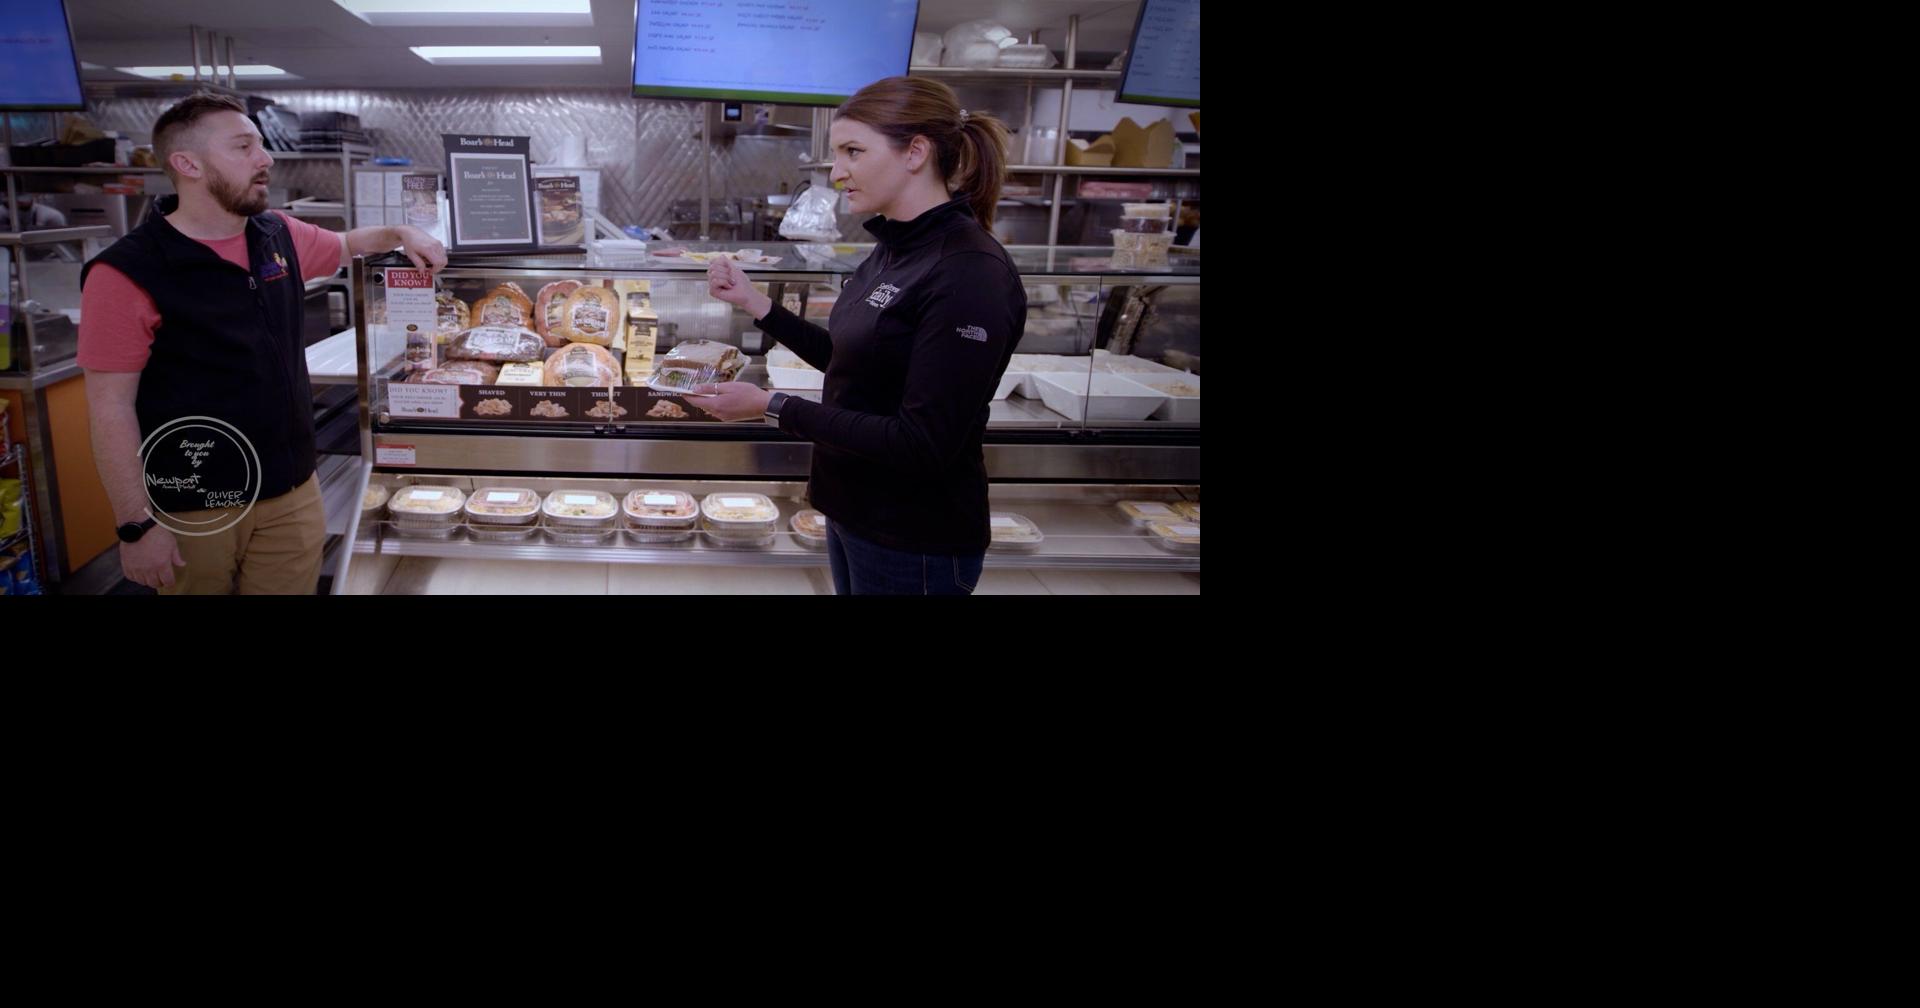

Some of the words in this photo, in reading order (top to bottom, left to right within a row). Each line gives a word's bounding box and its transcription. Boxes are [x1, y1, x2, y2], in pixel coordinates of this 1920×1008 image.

[493, 139, 514, 147] Head
[496, 171, 516, 179] Head
[394, 279, 427, 287] KNOW?
